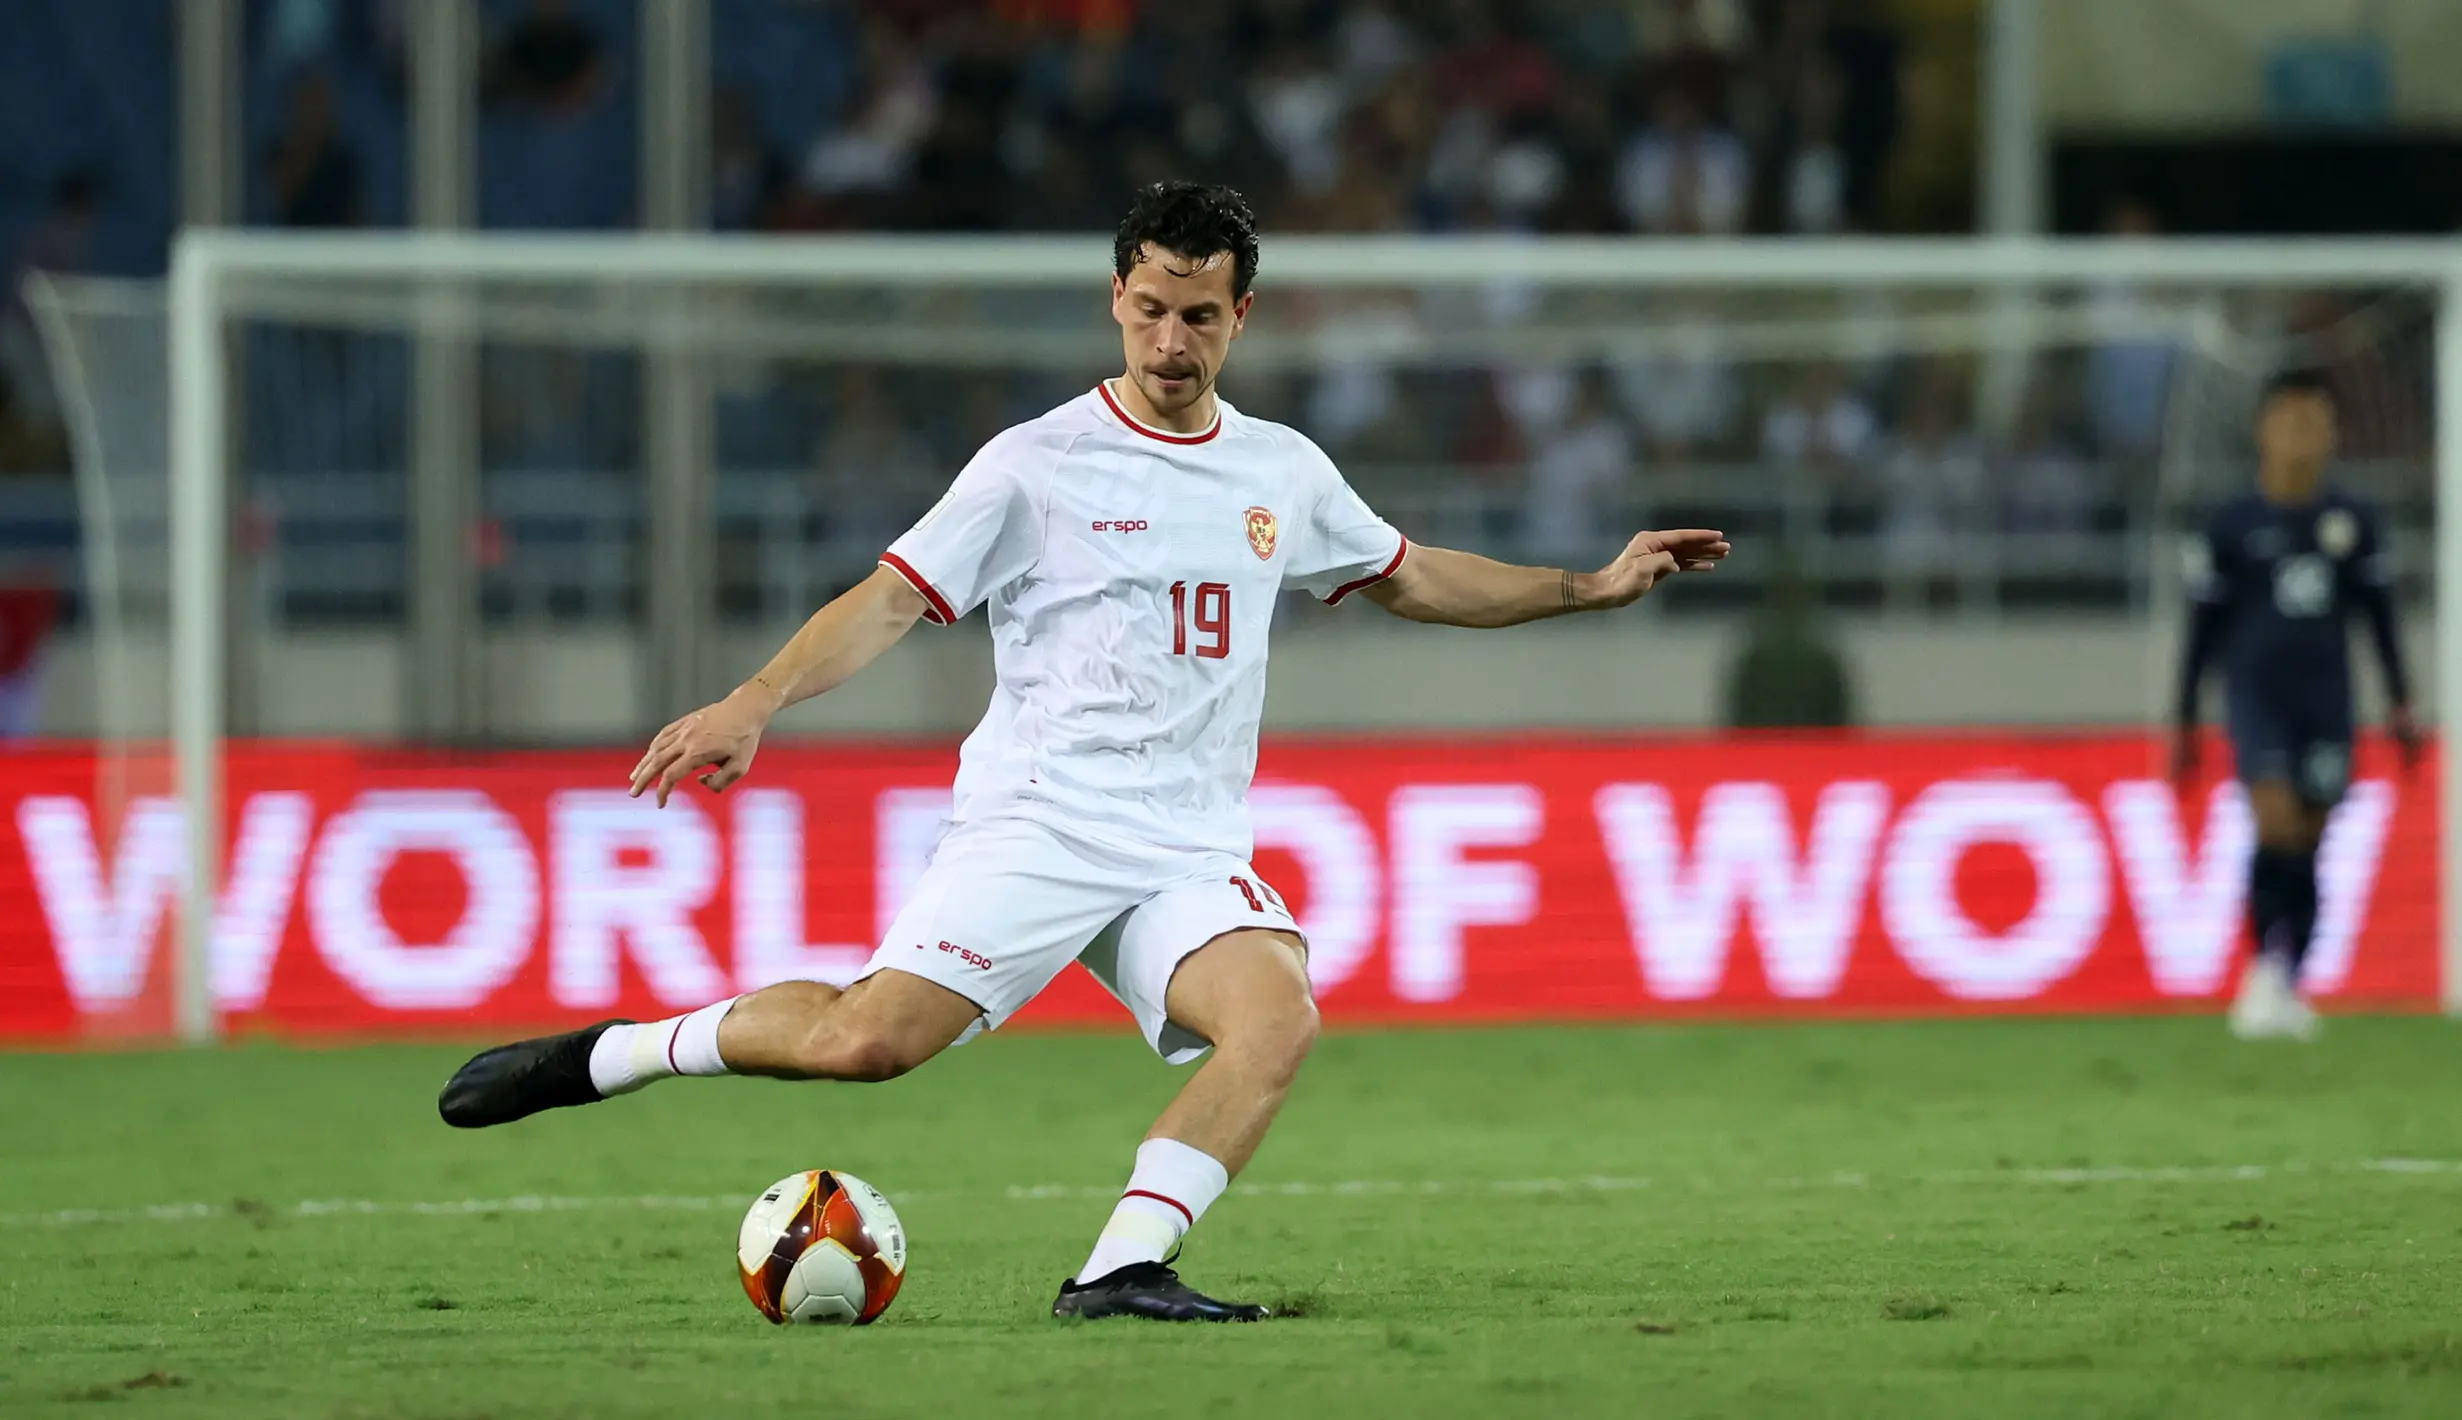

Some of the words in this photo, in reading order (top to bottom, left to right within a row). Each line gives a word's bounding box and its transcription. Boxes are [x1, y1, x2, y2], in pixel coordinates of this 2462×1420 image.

[1092, 520, 1148, 534] erspo
[1169, 580, 1231, 659] 19
[1594, 779, 2396, 1000] WOW
[938, 940, 992, 970] erspo
